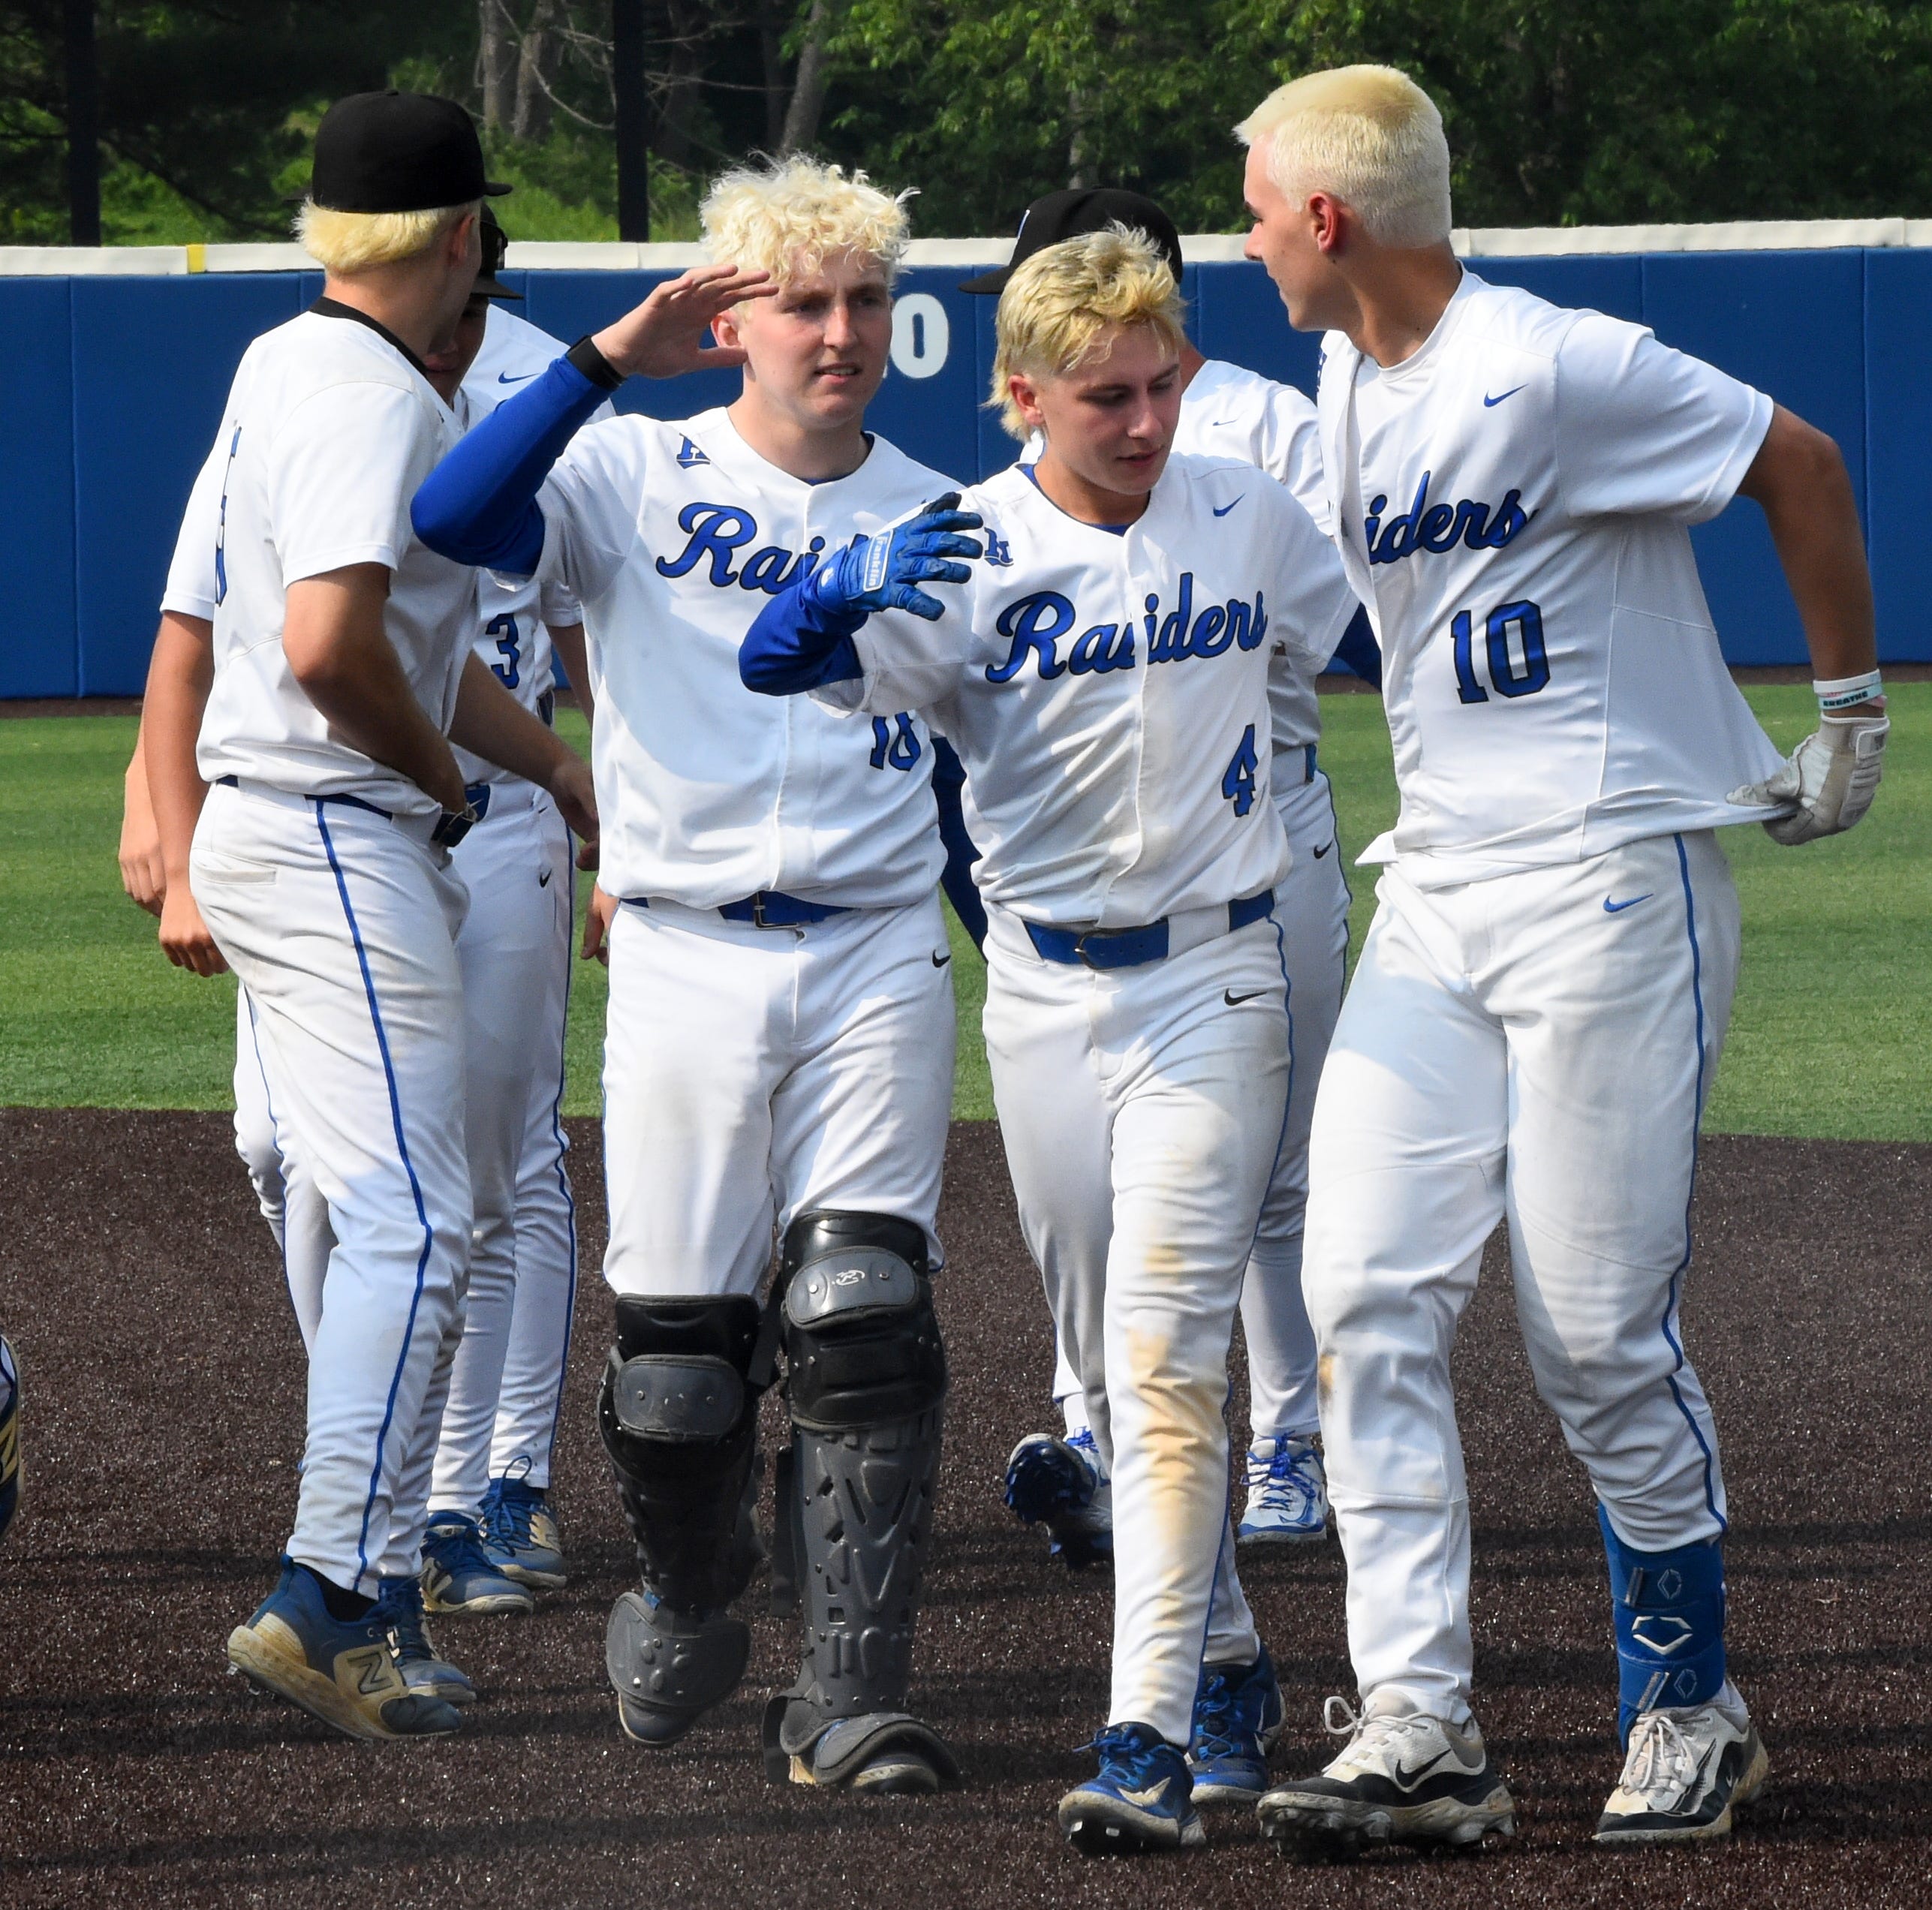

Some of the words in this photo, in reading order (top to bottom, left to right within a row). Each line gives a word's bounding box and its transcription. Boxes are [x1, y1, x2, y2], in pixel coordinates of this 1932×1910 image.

[883, 293, 949, 379] 0
[655, 501, 869, 595] Rai
[868, 535, 889, 587] Franklin
[1365, 470, 1539, 565] iders
[485, 612, 520, 690] 3
[985, 571, 1268, 684] Raiders
[1450, 599, 1551, 705] 10
[1221, 723, 1259, 818] 4
